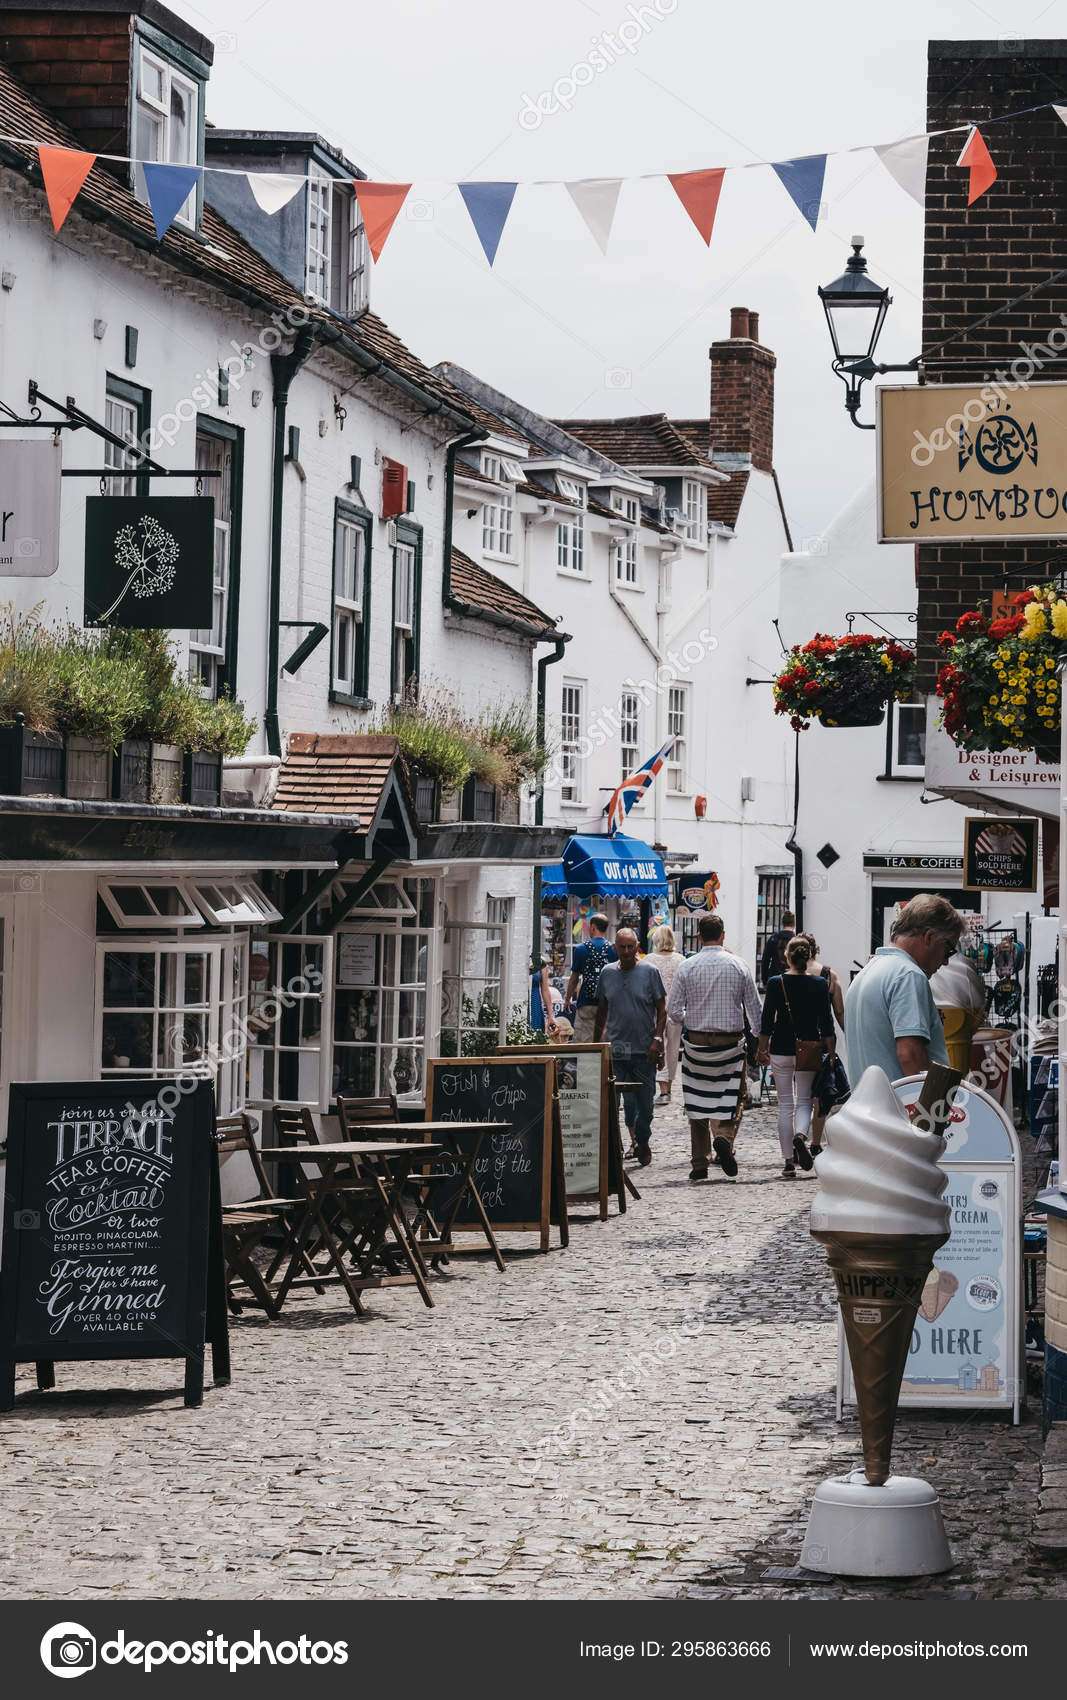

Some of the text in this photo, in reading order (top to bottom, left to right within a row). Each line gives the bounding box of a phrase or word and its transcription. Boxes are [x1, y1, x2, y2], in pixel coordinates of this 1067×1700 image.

[2, 511, 14, 542] r
[0, 556, 13, 565] ant
[958, 751, 1027, 766] Designer
[968, 768, 981, 781] &
[884, 857, 962, 868] TEA & COFFEE
[603, 862, 658, 883] OUT of the BLUE
[976, 878, 1023, 887] TAKEAWAY
[441, 1069, 478, 1096] Fish
[492, 1084, 527, 1111] Chips
[560, 1092, 590, 1100] EAKFAST
[59, 1106, 166, 1121] join us on our
[47, 1118, 174, 1165] TERRACE
[46, 1155, 171, 1192] TEA & COFFEE
[494, 1155, 508, 1180] of
[512, 1153, 531, 1173] the
[80, 1184, 95, 1195] or
[46, 1186, 164, 1231] Cocktail
[942, 1195, 968, 1208] NTRY
[102, 1213, 165, 1229] or two
[954, 1210, 988, 1224] CREAM
[54, 1243, 103, 1252] ESPRESSO
[39, 1259, 158, 1294] Forgive me
[98, 1278, 159, 1293] for I have
[36, 1283, 167, 1335] Ginned
[74, 1313, 101, 1322] OVER
[126, 1312, 157, 1320] GINS
[82, 1322, 144, 1332] AVAILABLE
[931, 1328, 983, 1355] HERE
